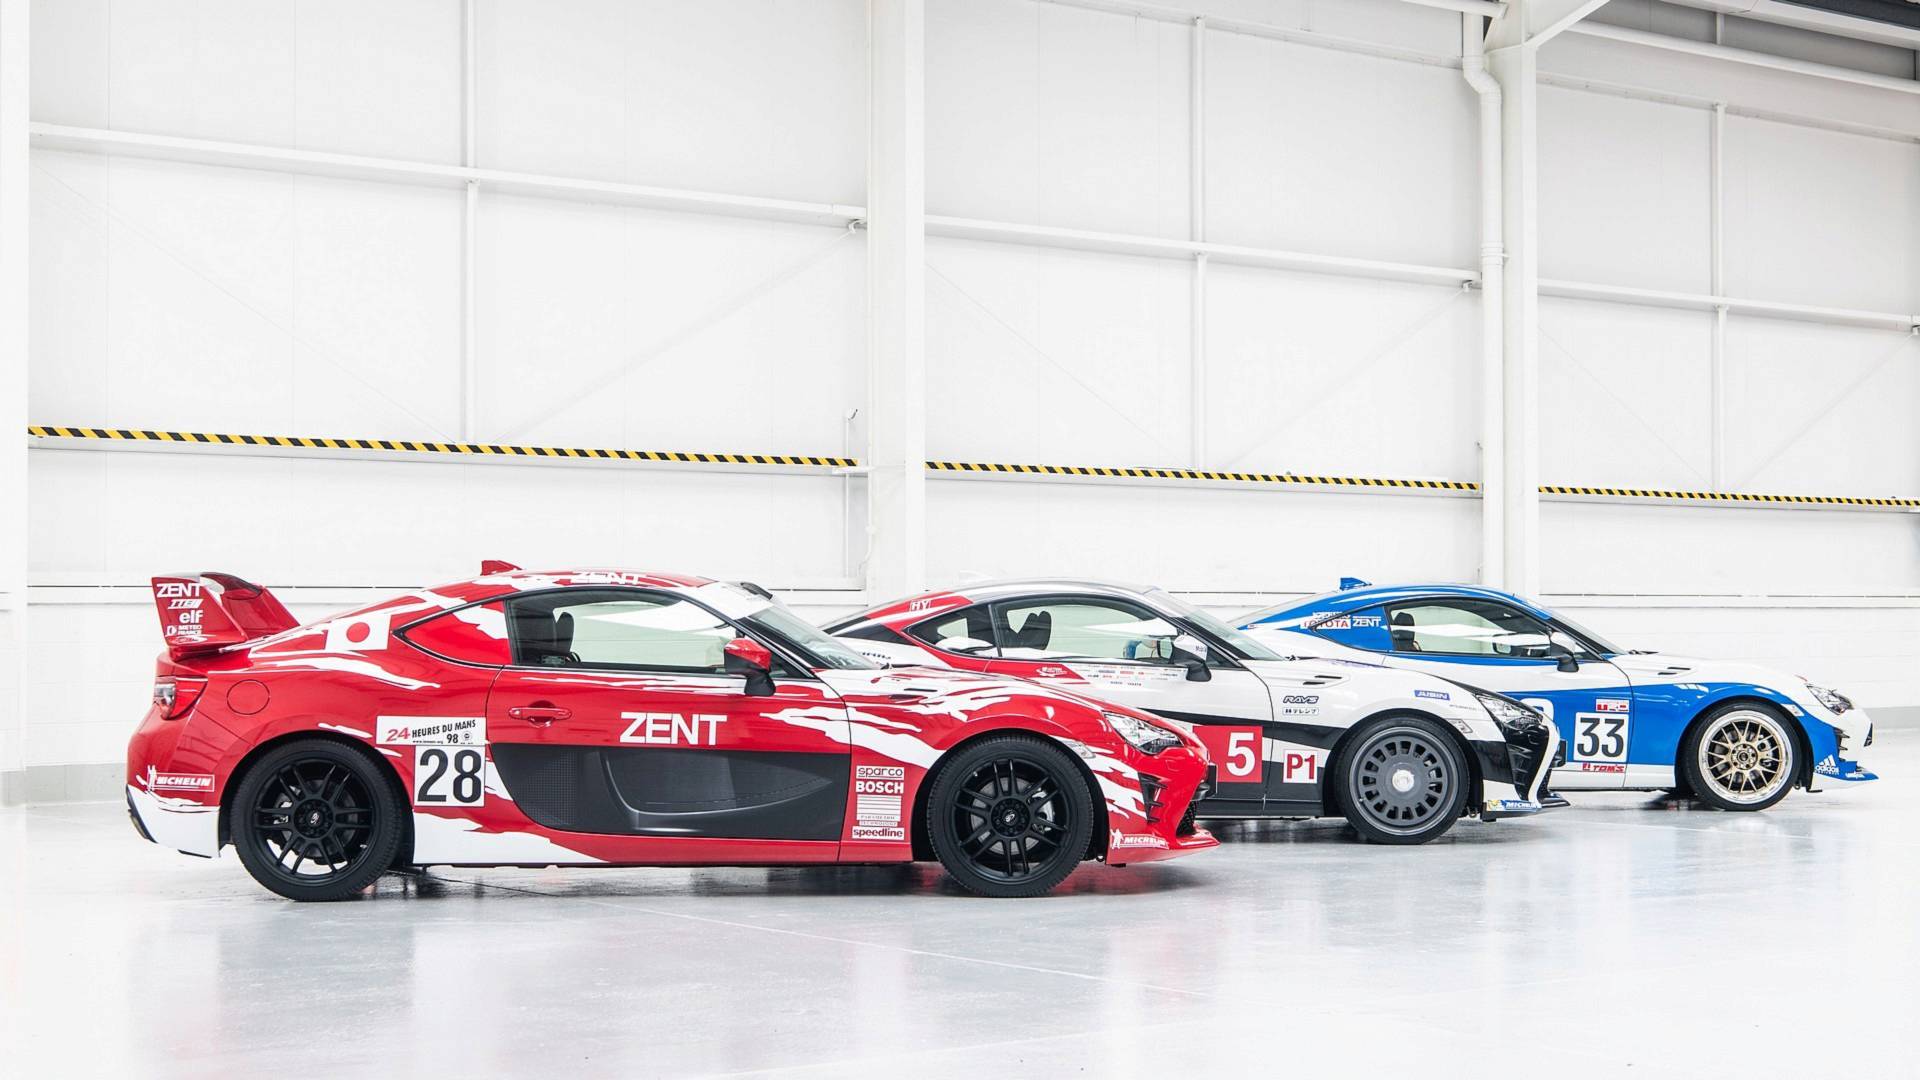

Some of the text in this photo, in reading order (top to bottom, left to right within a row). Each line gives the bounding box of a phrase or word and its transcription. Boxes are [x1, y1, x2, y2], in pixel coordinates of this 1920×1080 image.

[156, 583, 201, 598] ZENT
[179, 610, 204, 624] elf
[1352, 618, 1381, 627] ZENT
[1282, 695, 1320, 704] RAYS
[386, 719, 476, 742] 24 HEURES DU MANS
[620, 711, 728, 746] ZENT
[446, 733, 459, 744] 98
[1577, 717, 1625, 758] 33
[1226, 732, 1256, 777] 5
[858, 766, 904, 777] sparco
[1286, 753, 1316, 779] P1
[156, 776, 212, 787] MICHELIN
[417, 748, 482, 804] 28
[855, 780, 904, 794] BOSCH
[853, 827, 904, 838] speedline
